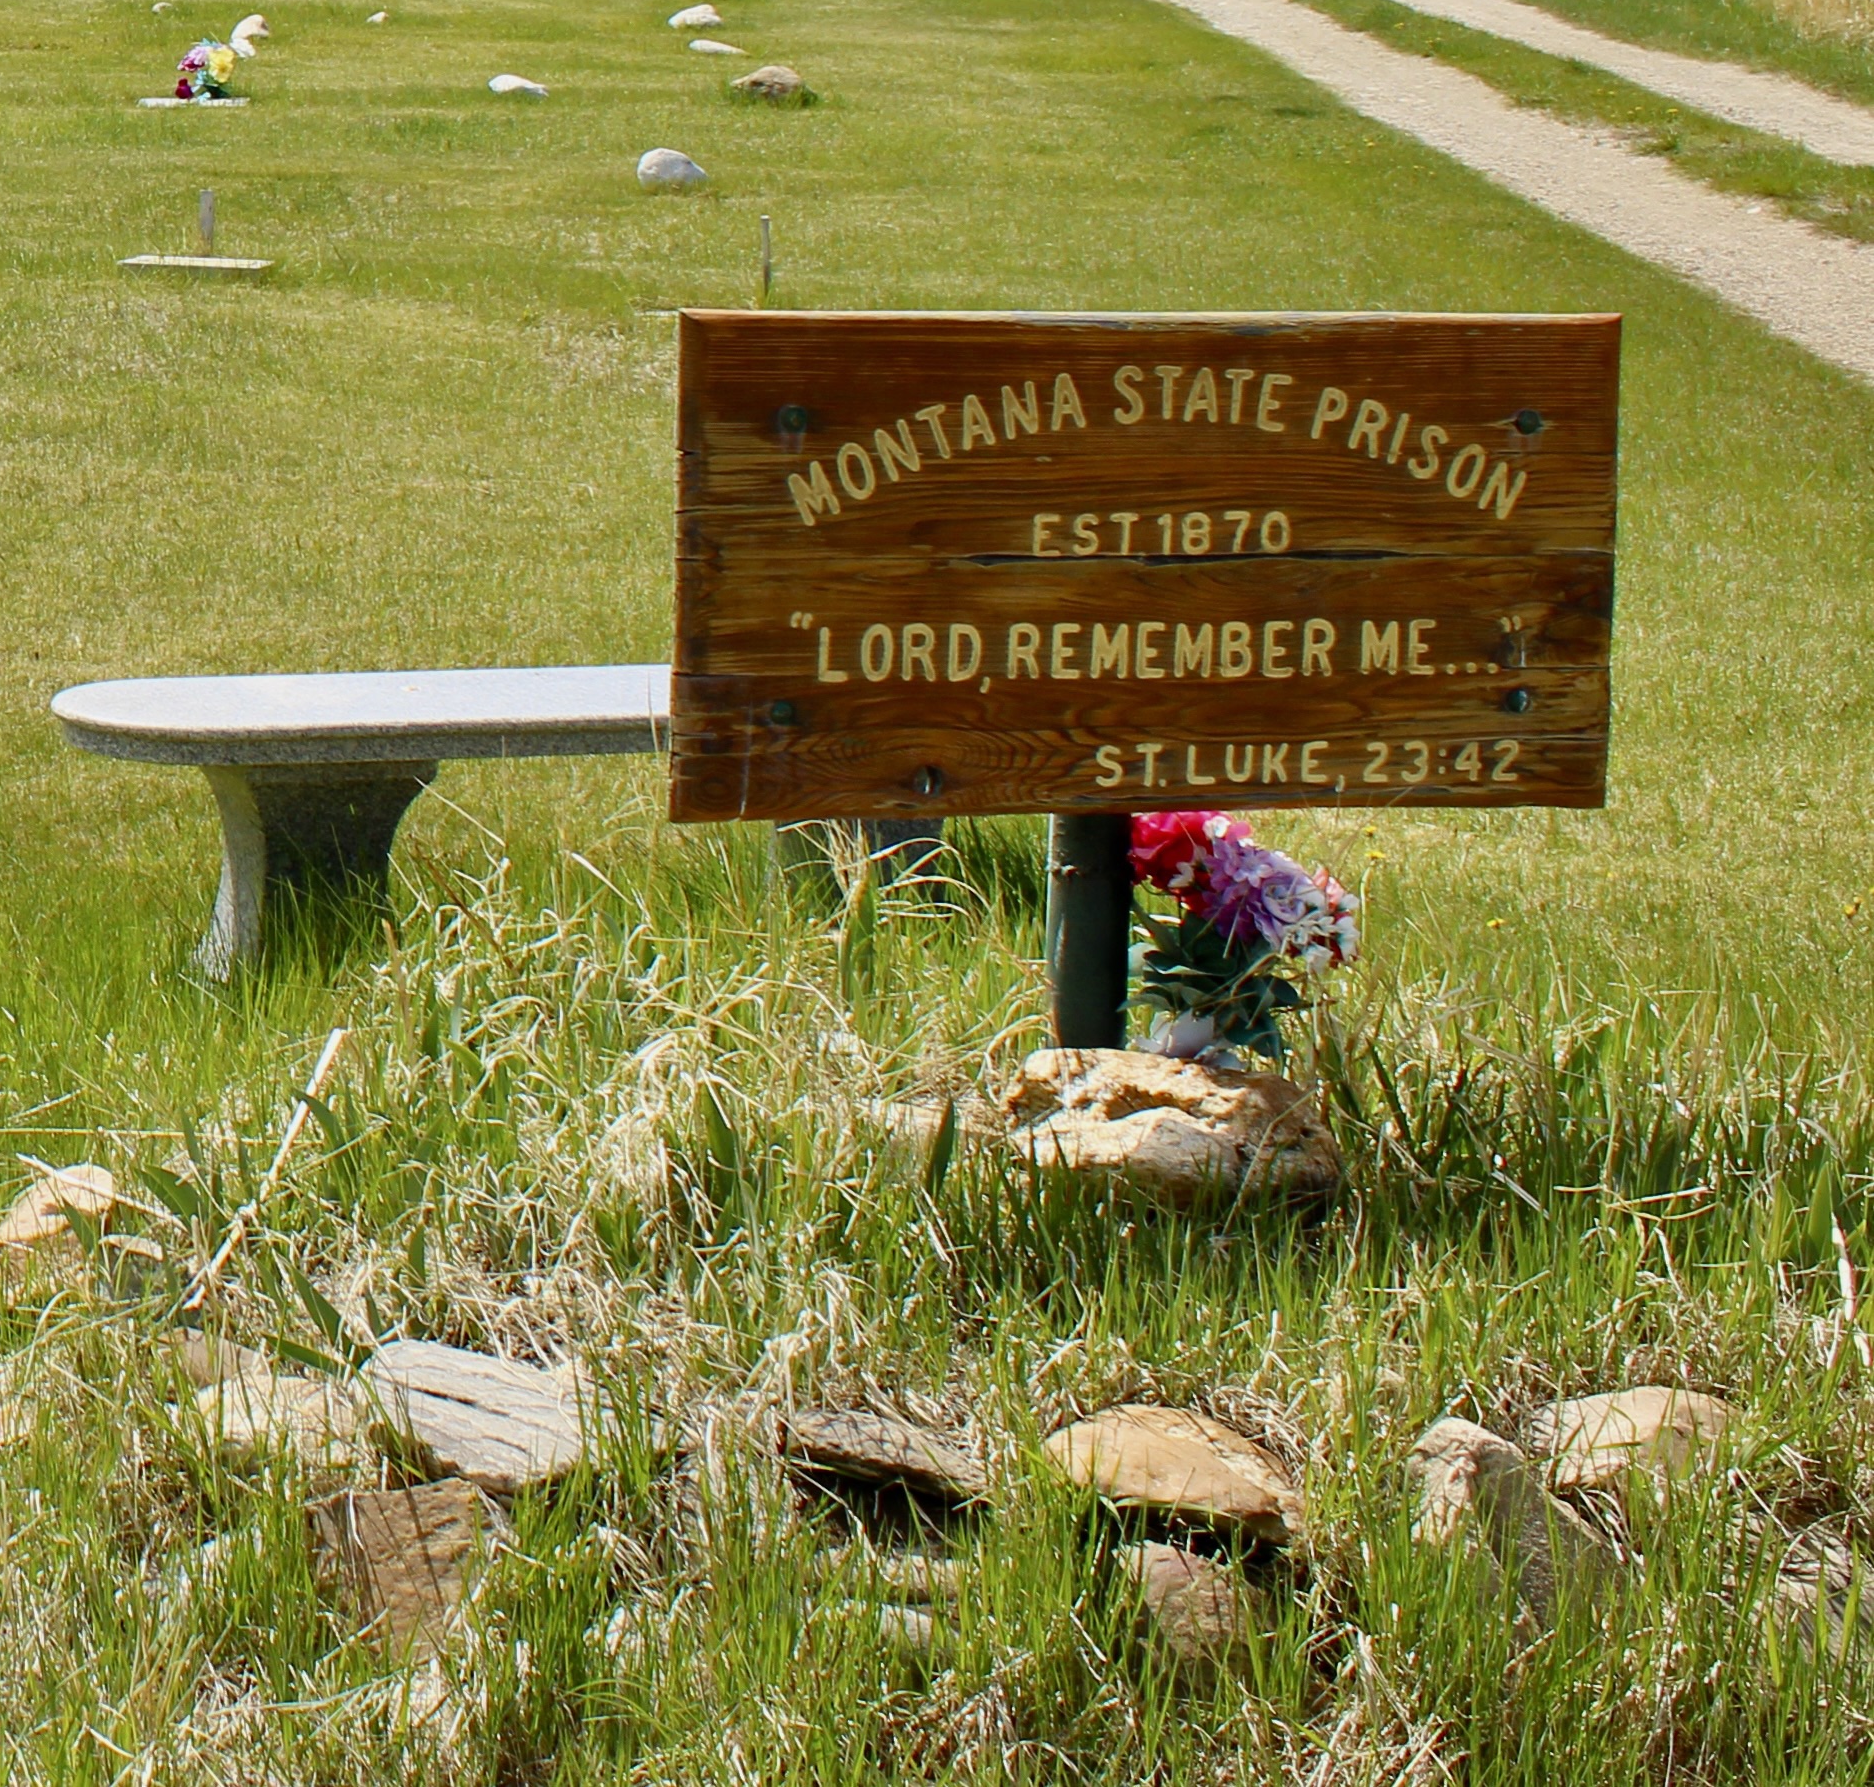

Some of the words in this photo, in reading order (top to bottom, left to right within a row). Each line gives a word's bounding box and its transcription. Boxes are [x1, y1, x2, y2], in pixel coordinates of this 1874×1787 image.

[787, 372, 1087, 527] MONTANA
[1113, 365, 1294, 433] STATE
[1309, 387, 1528, 521] PRISON
[1156, 510, 1292, 556] 1870
[1006, 618, 1337, 680] REMEMBER
[1094, 744, 1168, 788] ST.
[1185, 740, 1347, 793] LUKE,
[1362, 739, 1520, 783] 23:42
